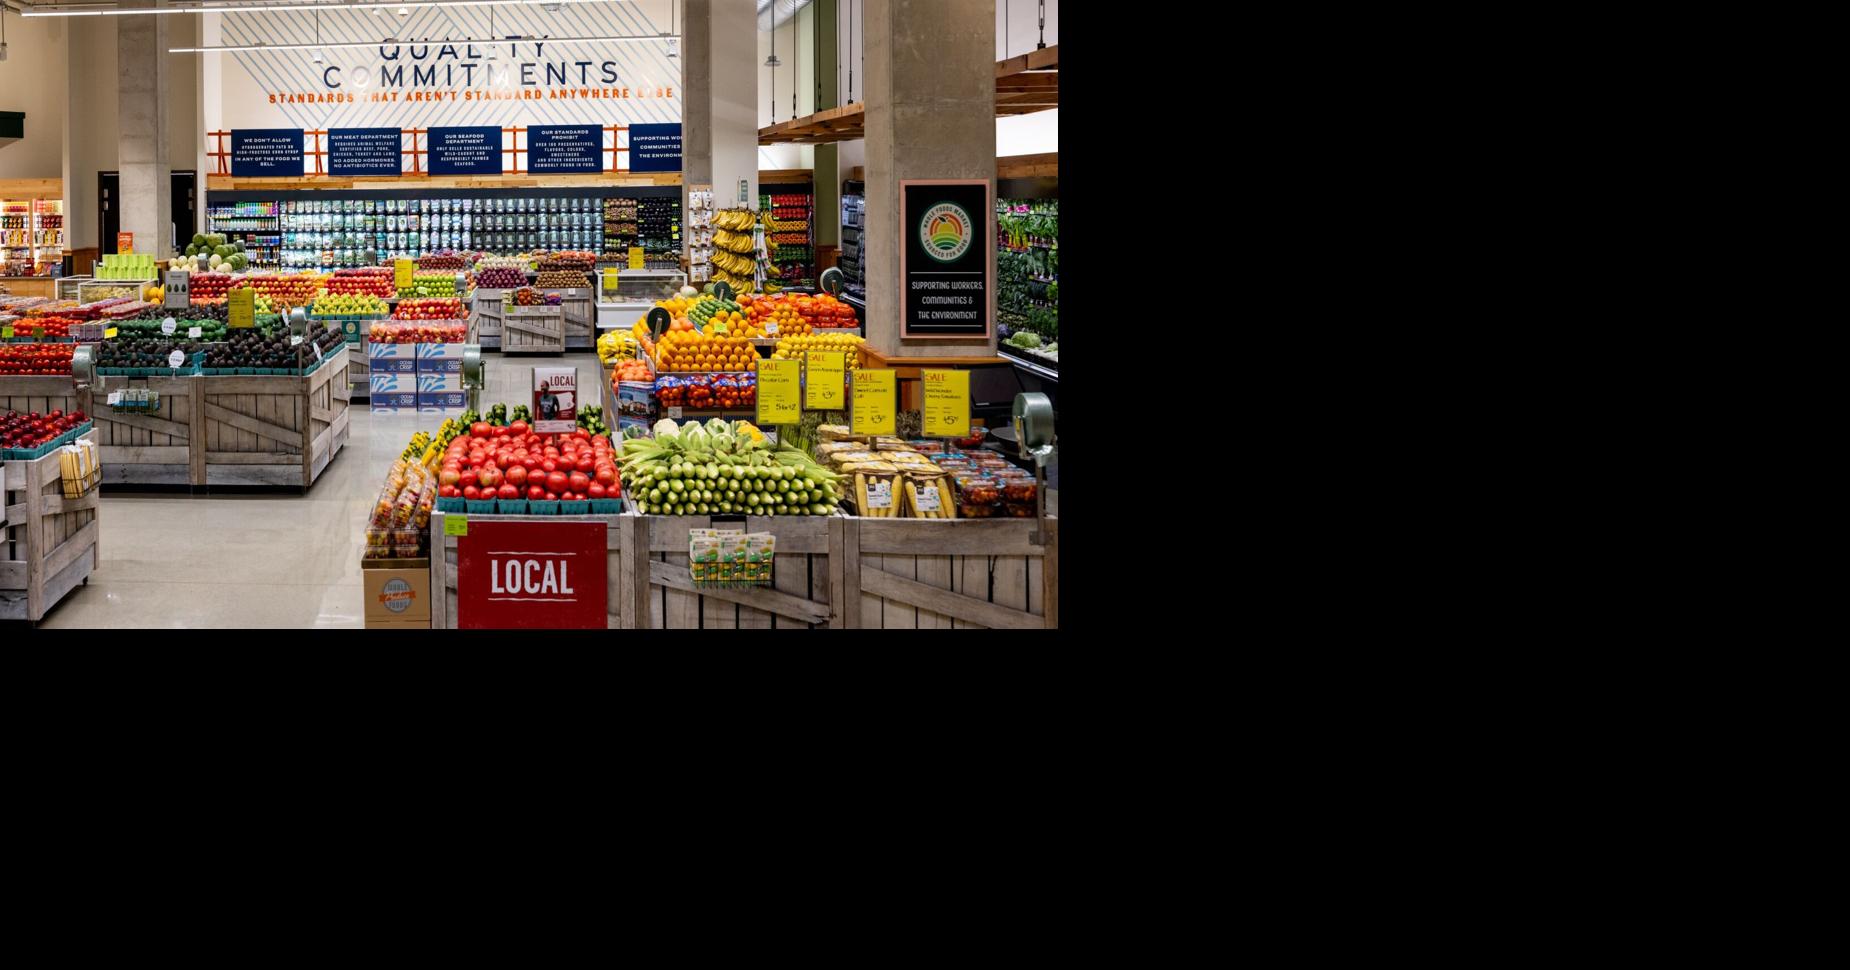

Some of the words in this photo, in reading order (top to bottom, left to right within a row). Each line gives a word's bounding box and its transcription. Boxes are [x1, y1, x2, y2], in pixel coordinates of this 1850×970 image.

[379, 35, 549, 60] QUALTY
[269, 92, 354, 104] STANDARDS
[363, 92, 398, 102] HAT
[406, 91, 457, 102] AREN'T
[550, 88, 629, 98] ANYWHERE
[637, 88, 673, 98] ESE
[912, 281, 950, 289] SUPPORTING
[922, 296, 967, 304] COMMUNITIES
[918, 311, 930, 319] THE
[931, 311, 977, 319] ENVIRONMENT
[550, 376, 575, 386] LOCAL
[491, 559, 574, 594] LOCAL
